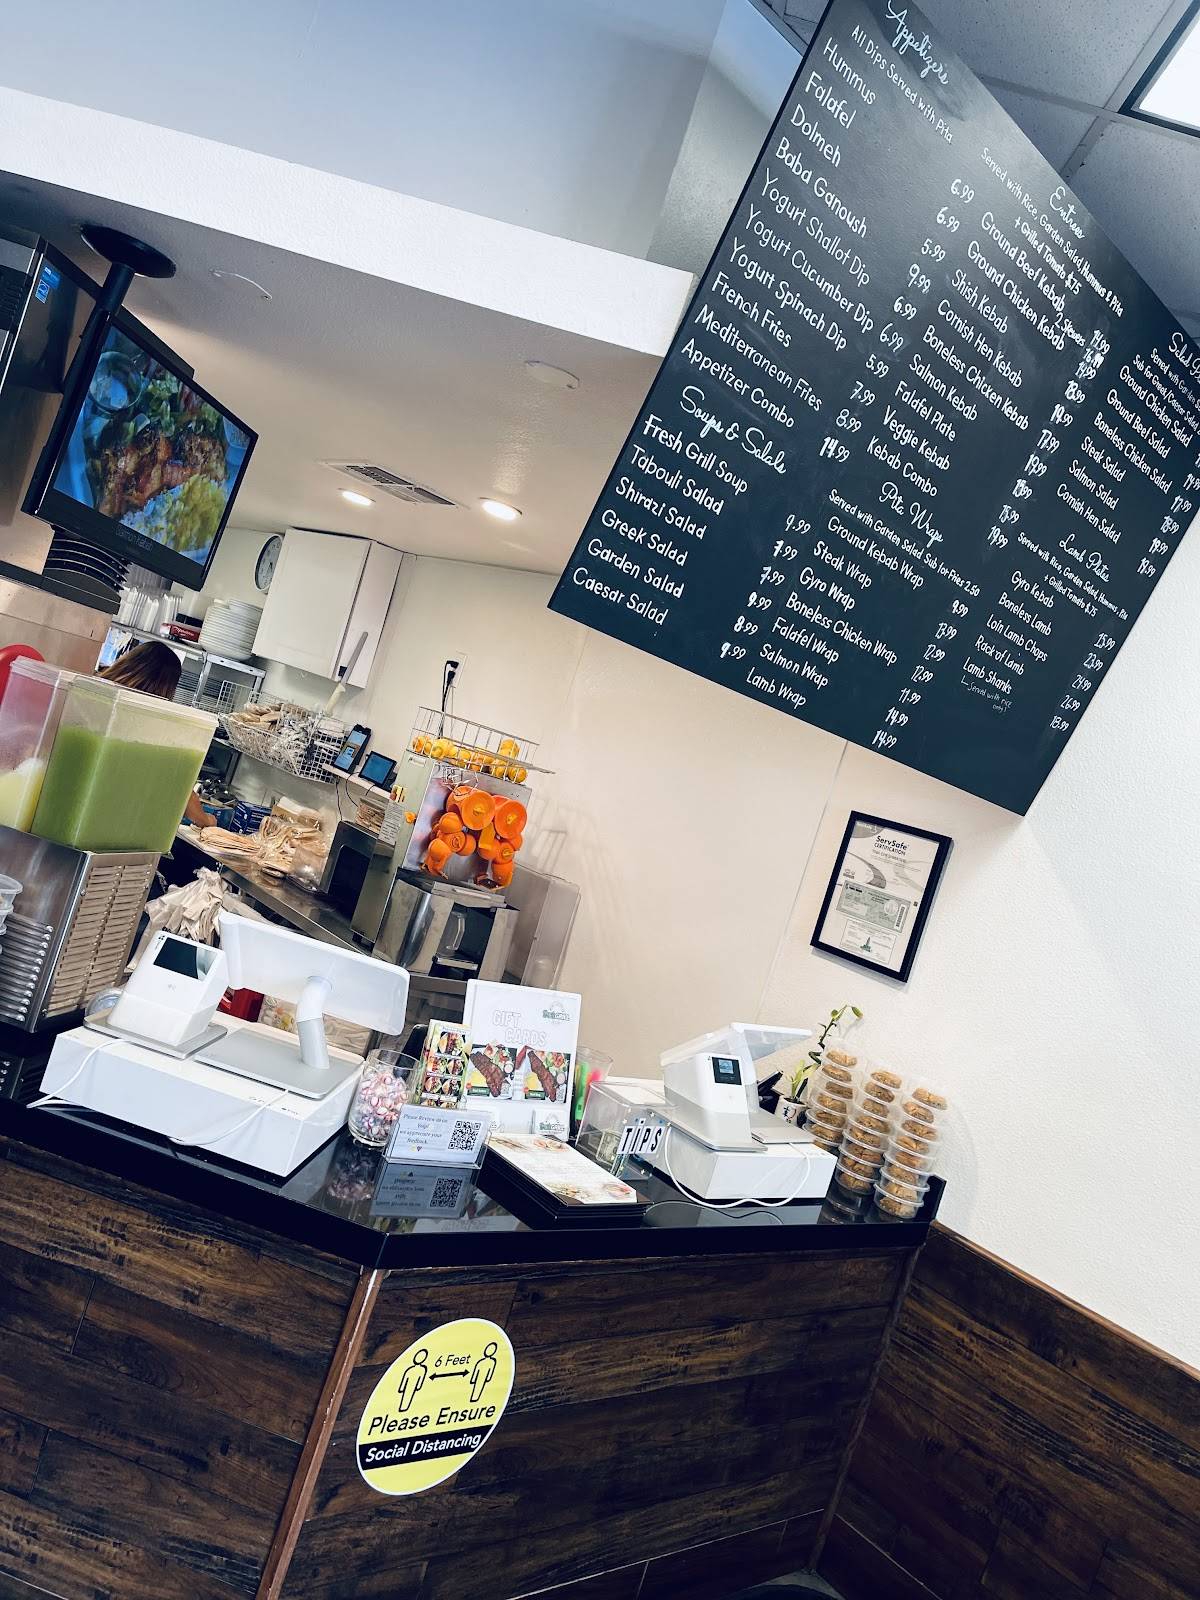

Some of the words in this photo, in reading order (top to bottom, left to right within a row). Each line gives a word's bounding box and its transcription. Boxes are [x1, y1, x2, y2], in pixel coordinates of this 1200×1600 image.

[823, 37, 876, 104] Hummus
[950, 179, 974, 203] 6.99
[865, 42, 886, 69] Dips
[887, 64, 918, 104] Served
[918, 97, 934, 124] with
[935, 118, 953, 144] Pita
[791, 104, 841, 167] Dolmeh
[921, 239, 946, 262] 5.99
[805, 71, 857, 129] Falafel
[936, 207, 960, 233] 6.99
[775, 137, 812, 184] Baba
[814, 177, 868, 238] Ganoush
[908, 264, 931, 294] 9.99
[981, 148, 1007, 182] Served
[1006, 176, 1022, 200] with
[1039, 214, 1065, 251] Garden
[745, 204, 792, 256] Yogurt
[792, 250, 853, 313] Cucumber
[853, 303, 874, 334] Dip
[880, 322, 904, 352] 6.99
[761, 168, 807, 226] Yogurt
[806, 217, 850, 265] Shallot
[849, 256, 870, 287] Dip
[893, 296, 917, 320] 6.99
[981, 211, 1017, 259] Ground
[1016, 251, 1042, 282] Beef
[1038, 277, 1065, 314] Kebab
[1020, 222, 1043, 253] Grilled
[1042, 244, 1066, 280] Tomato
[730, 237, 775, 289] Yogurt
[775, 280, 826, 332] Spinach
[826, 322, 847, 351] Dip
[866, 354, 889, 378] 5.99
[967, 240, 1003, 288] Ground
[1002, 279, 1038, 326] Chicken
[1037, 315, 1065, 352] Kebab
[694, 304, 793, 389] Mediterranean
[793, 378, 822, 411] Fries
[836, 409, 862, 433] 8.99
[711, 271, 759, 321] French
[761, 309, 792, 348] Fries
[849, 381, 876, 406] 7.99
[937, 299, 976, 343] Cornish
[977, 332, 995, 361] Hen
[993, 350, 1023, 388] Kebab
[1051, 403, 1073, 426] 19.99
[951, 269, 979, 304] Shish
[977, 296, 1008, 334] Kebab
[1065, 380, 1086, 403] 18.99
[681, 338, 750, 396] Appetizer
[751, 387, 794, 427] Combo
[819, 436, 850, 462] 14.99
[894, 380, 929, 421] Falafel
[931, 409, 956, 442] Plate
[910, 354, 947, 396] Salmon
[947, 384, 977, 421] Kebab
[1024, 453, 1047, 477] 19.99
[922, 324, 965, 374] Boneless
[966, 365, 1002, 408] Chicken
[1000, 397, 1029, 431] Kebab
[1037, 429, 1060, 454] 17.99
[1107, 389, 1135, 424] Ground
[1133, 415, 1152, 440] Beef
[1148, 432, 1171, 459] Salad
[1120, 365, 1148, 400] Ground
[1146, 393, 1172, 429] Chicken
[1171, 420, 1193, 448] Salad
[643, 414, 682, 453] Fresh
[685, 443, 716, 473] Grill
[716, 461, 748, 496] Soup
[884, 404, 916, 448] Veggie
[918, 437, 950, 471] Kebab
[1081, 436, 1104, 463] Steak
[1103, 456, 1126, 482] Salad
[1094, 412, 1125, 450] Boneless
[1124, 443, 1151, 475] Chicken
[1150, 468, 1173, 494] Salad
[615, 476, 665, 516] Shirazi
[664, 507, 707, 539] Salad
[630, 444, 682, 490] Tabouli
[683, 479, 724, 515] Salad
[867, 435, 901, 469] Kebab
[903, 462, 937, 497] Combo
[987, 525, 1008, 549] 19.99
[879, 481, 904, 516] Pita
[1069, 459, 1097, 493] Salmon
[1096, 484, 1120, 510] Salad
[601, 509, 643, 545] Greek
[648, 534, 688, 566] Salad
[828, 516, 866, 552] Ground
[866, 541, 898, 571] Kebab
[900, 560, 924, 590] Wrap
[829, 488, 856, 517] Served
[874, 520, 901, 547] Garden
[901, 539, 922, 560] Salad
[1018, 532, 1039, 553] Served
[1059, 533, 1084, 563] Lamb
[1084, 504, 1101, 527] Hen
[1098, 517, 1121, 544] Salad
[573, 567, 625, 603] Caesar
[627, 593, 670, 626] Salad
[587, 538, 640, 579] Garden
[644, 568, 684, 599] Salad
[814, 540, 843, 571] Steak
[846, 559, 872, 590] Wrap
[1011, 571, 1030, 591] Gyro
[1031, 583, 1054, 609] Kebab
[785, 592, 832, 629] Boneless
[833, 620, 873, 653] Chicken
[873, 636, 897, 666] Wrap
[910, 665, 934, 683] 12.99
[800, 566, 827, 597] Gyro
[828, 582, 855, 611] Wrap
[923, 644, 946, 662] 12.99
[987, 614, 1004, 635] Loin
[1003, 625, 1024, 648] Lamb
[1024, 639, 1048, 662] Chops
[998, 592, 1032, 623] Boneless
[1031, 613, 1052, 636] Lamb
[759, 644, 801, 676] Salmon
[801, 659, 829, 689] Wrap
[885, 706, 909, 727] 14.99
[772, 617, 812, 648] Falafel
[811, 637, 839, 665] Wrap
[899, 687, 921, 705] 11.99
[963, 656, 986, 678] Lamb
[986, 672, 1012, 695] Shanks
[975, 635, 996, 657] Rack
[1004, 652, 1025, 675] Lamb
[746, 667, 776, 695] Lamb
[777, 682, 807, 710] Wrap
[872, 729, 897, 749] 14.99
[876, 835, 908, 850] ServSafe
[505, 1028, 548, 1046] CARDS
[434, 1356, 441, 1368] 6
[365, 1442, 411, 1463] Social
[411, 1434, 482, 1455] Distancing
[367, 1414, 430, 1436] Please
[435, 1405, 496, 1426] Ensure
